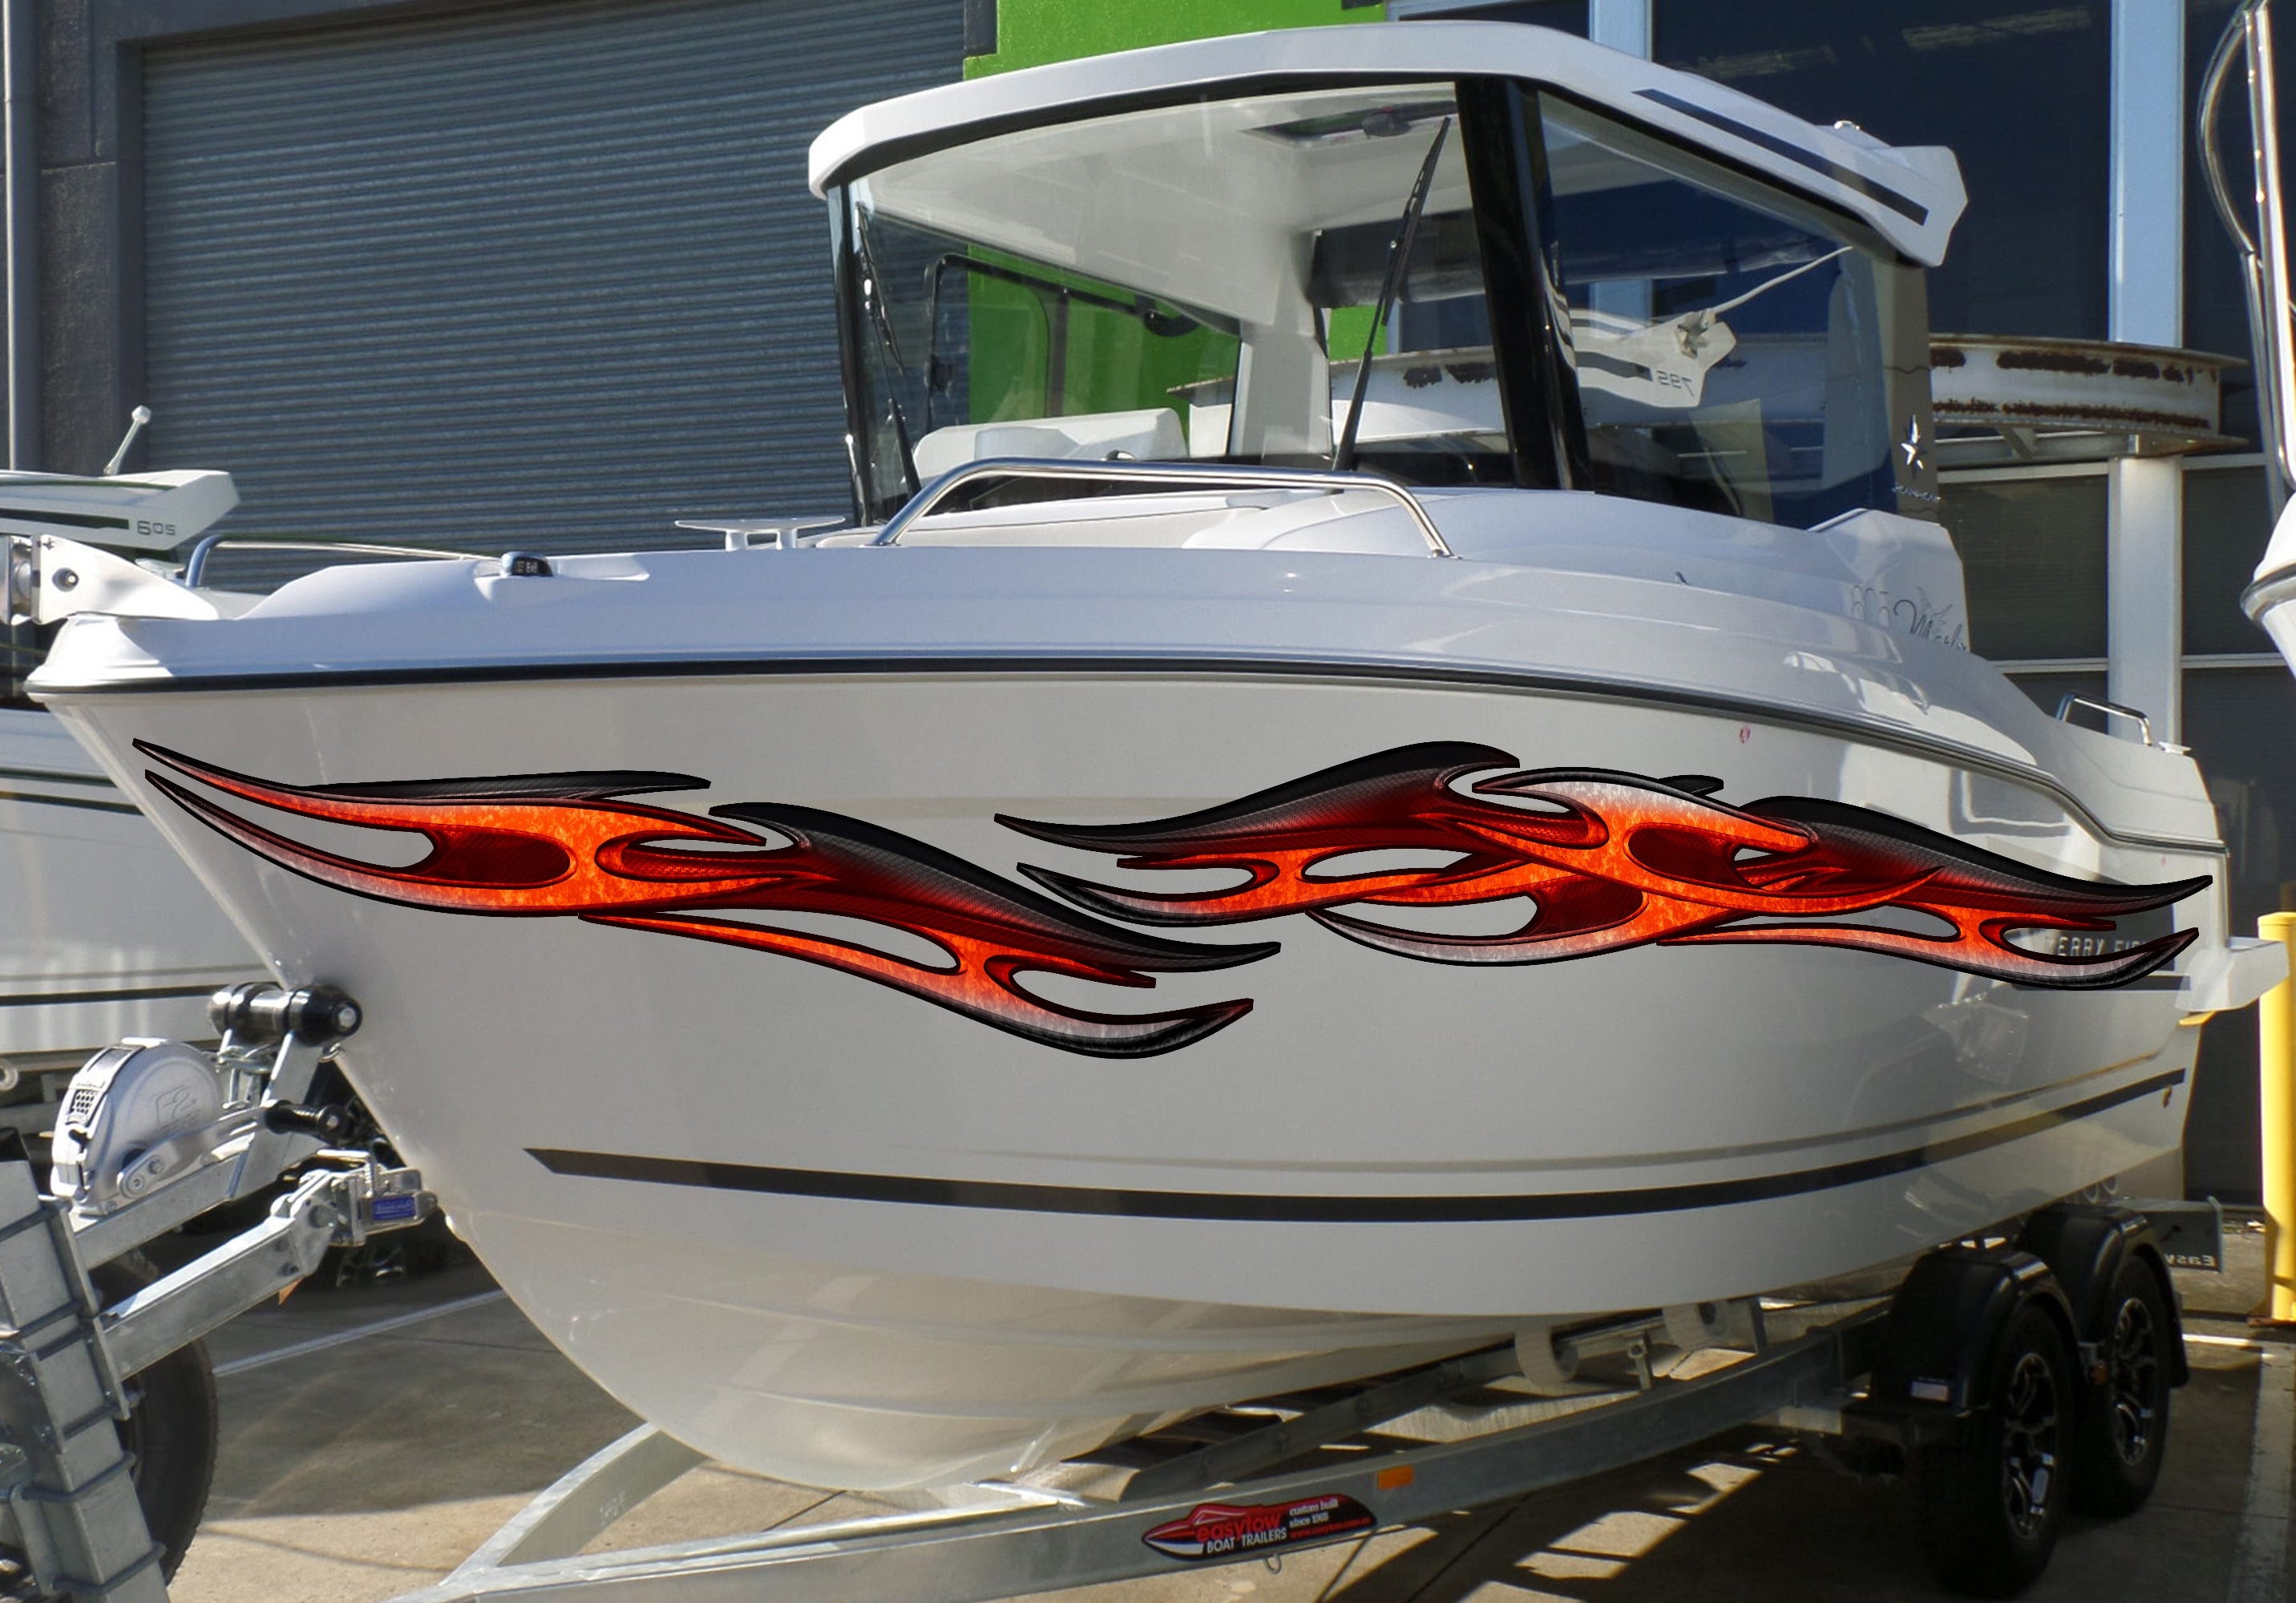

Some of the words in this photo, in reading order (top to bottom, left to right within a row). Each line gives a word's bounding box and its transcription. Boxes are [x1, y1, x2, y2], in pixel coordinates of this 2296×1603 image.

[137, 520, 176, 535] 605
[2045, 936, 2104, 956] ERRY
[1289, 1502, 1319, 1516] custom
[1320, 1498, 1339, 1511] built
[1195, 1513, 1282, 1543] easytow
[1289, 1515, 1310, 1528] since
[1207, 1536, 1235, 1553] BOAT
[1242, 1528, 1287, 1548] TRAILERS
